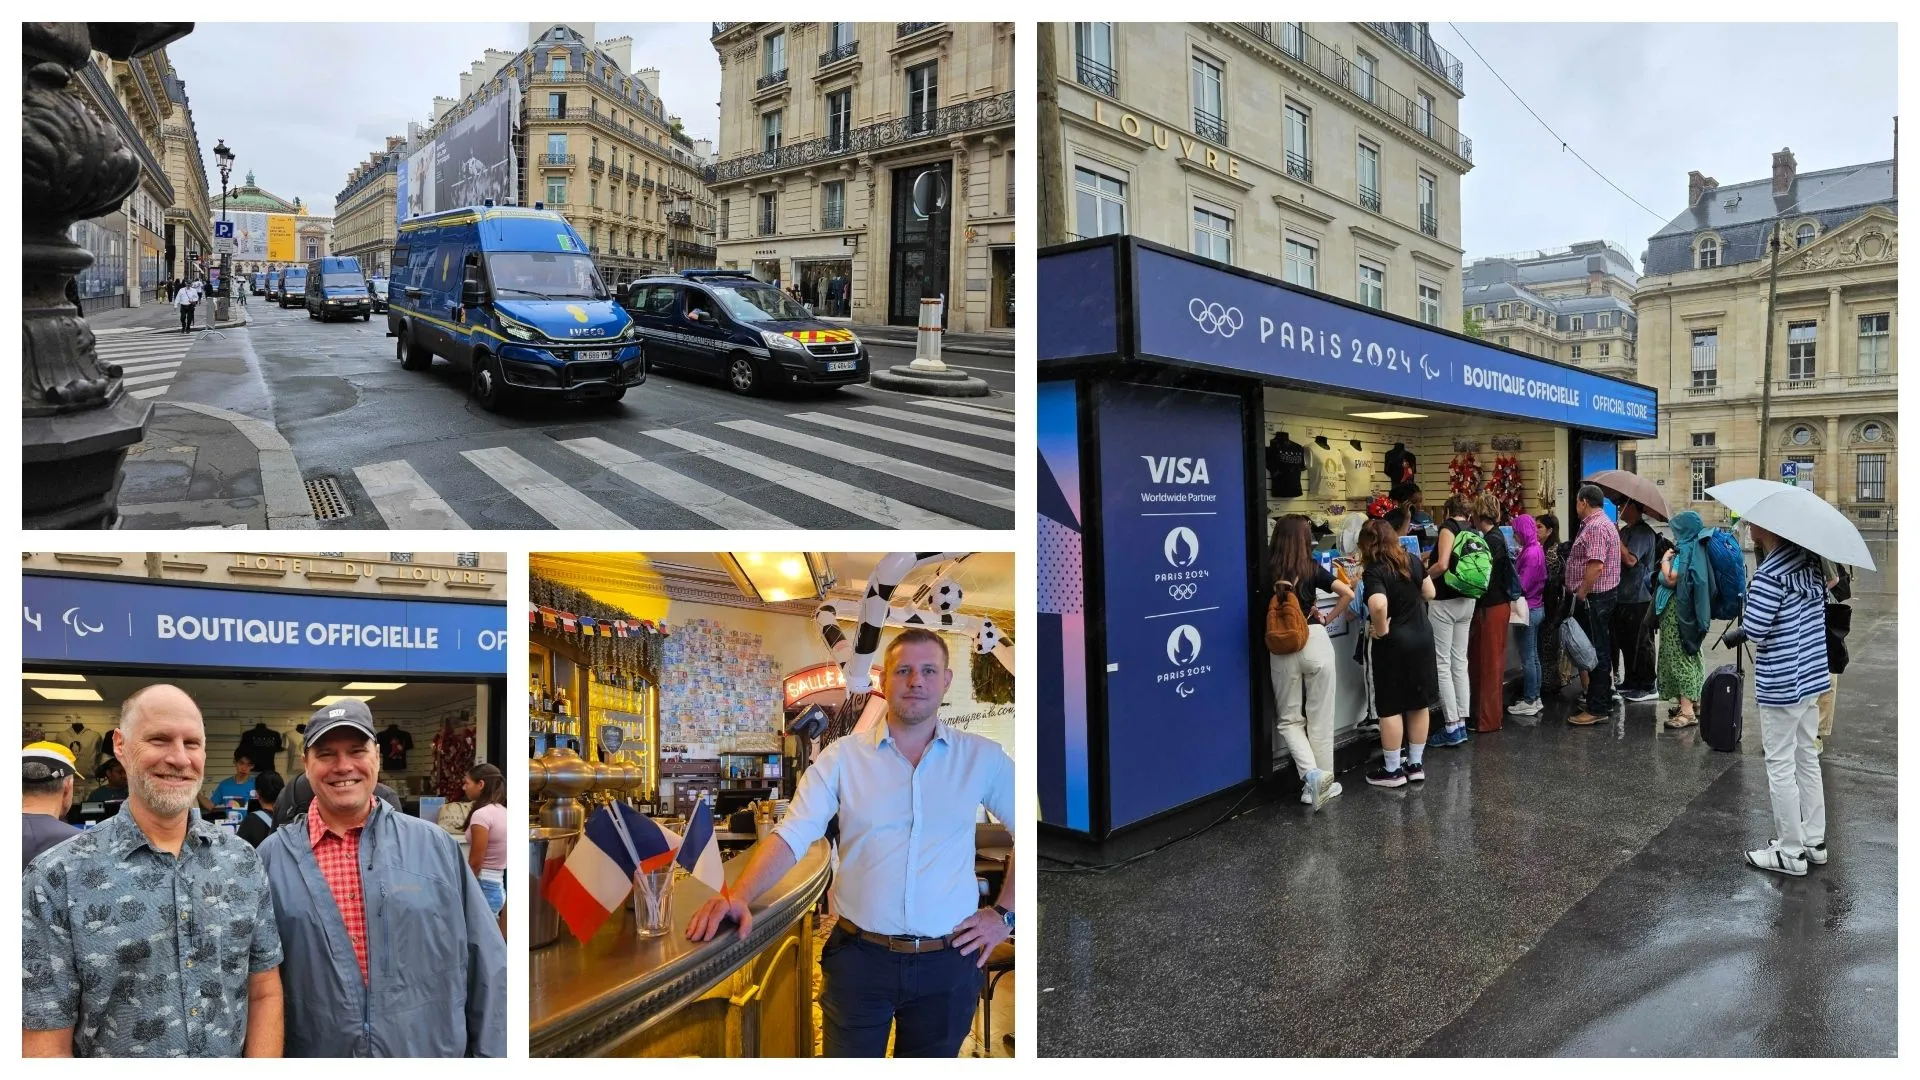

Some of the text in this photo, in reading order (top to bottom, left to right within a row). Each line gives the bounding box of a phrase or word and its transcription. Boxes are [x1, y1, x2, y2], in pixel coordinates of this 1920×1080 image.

[1096, 101, 1240, 179] LOUVRE
[219, 224, 229, 236] P
[569, 327, 606, 337] IVECO
[1259, 316, 1648, 420] PARIS 2024 BOUTIQUE OFFICIELLE OFFICIAL STORE
[1140, 455, 1210, 485] VISA
[1140, 492, 1217, 502] Worldwide Partner
[236, 554, 487, 584] HOTEL DU LOUVRE
[1155, 569, 1209, 582] PARIS 2024
[157, 614, 300, 645] BOUTIQUE
[305, 622, 439, 649] OFFICIELLE
[477, 629, 507, 651] OF
[787, 669, 836, 698] SALLE
[1157, 664, 1211, 683] PARIS 2024
[940, 712, 981, 730] ampagne
